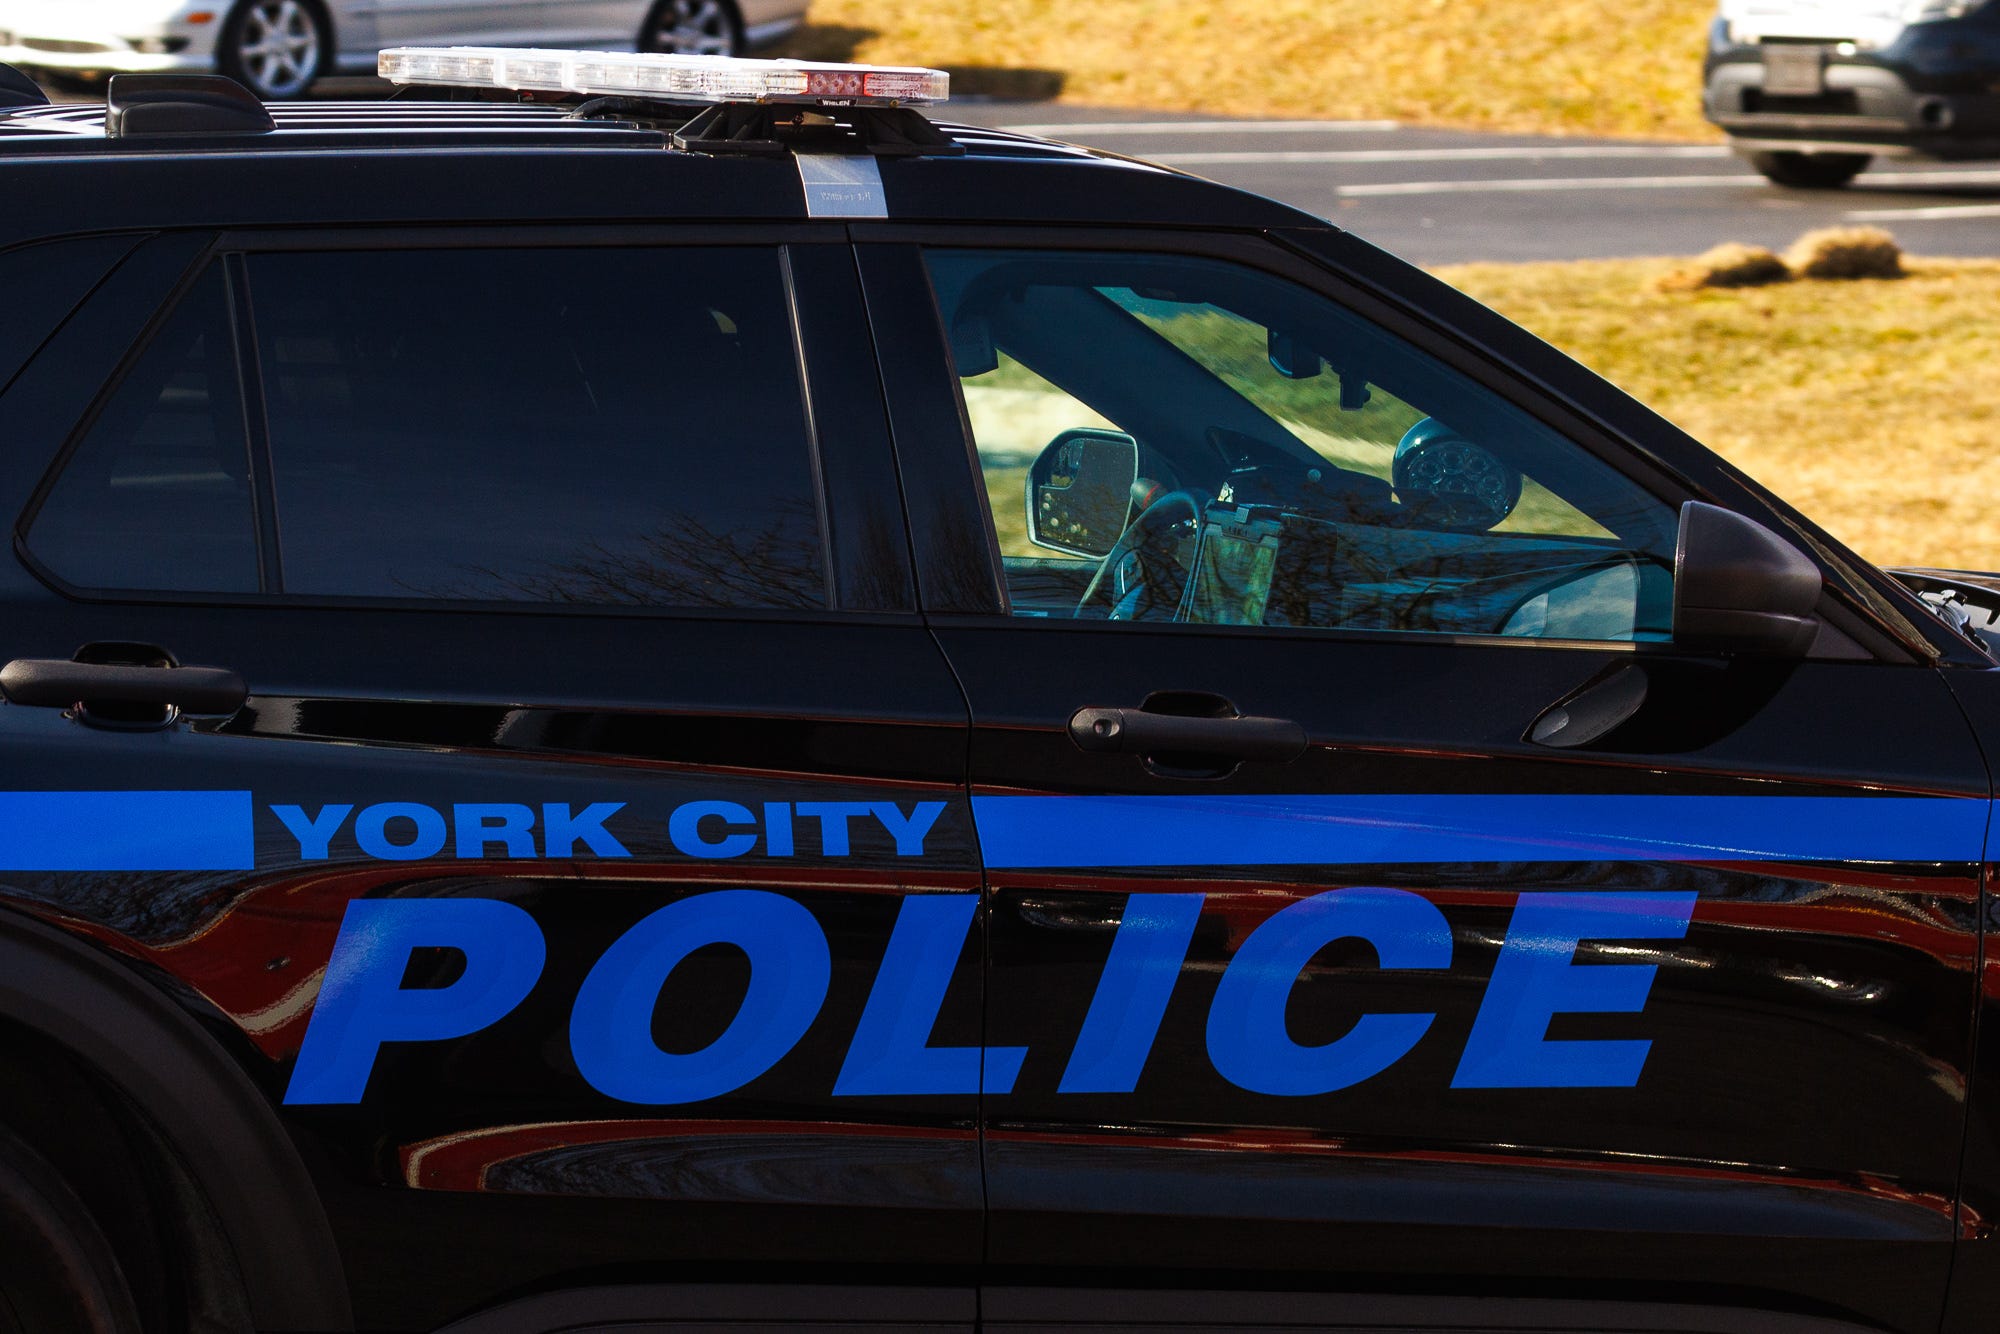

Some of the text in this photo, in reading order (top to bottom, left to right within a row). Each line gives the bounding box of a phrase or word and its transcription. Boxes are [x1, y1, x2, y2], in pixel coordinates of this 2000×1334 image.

[269, 799, 948, 861] YORK CITY
[282, 886, 1698, 1105] POLICE
